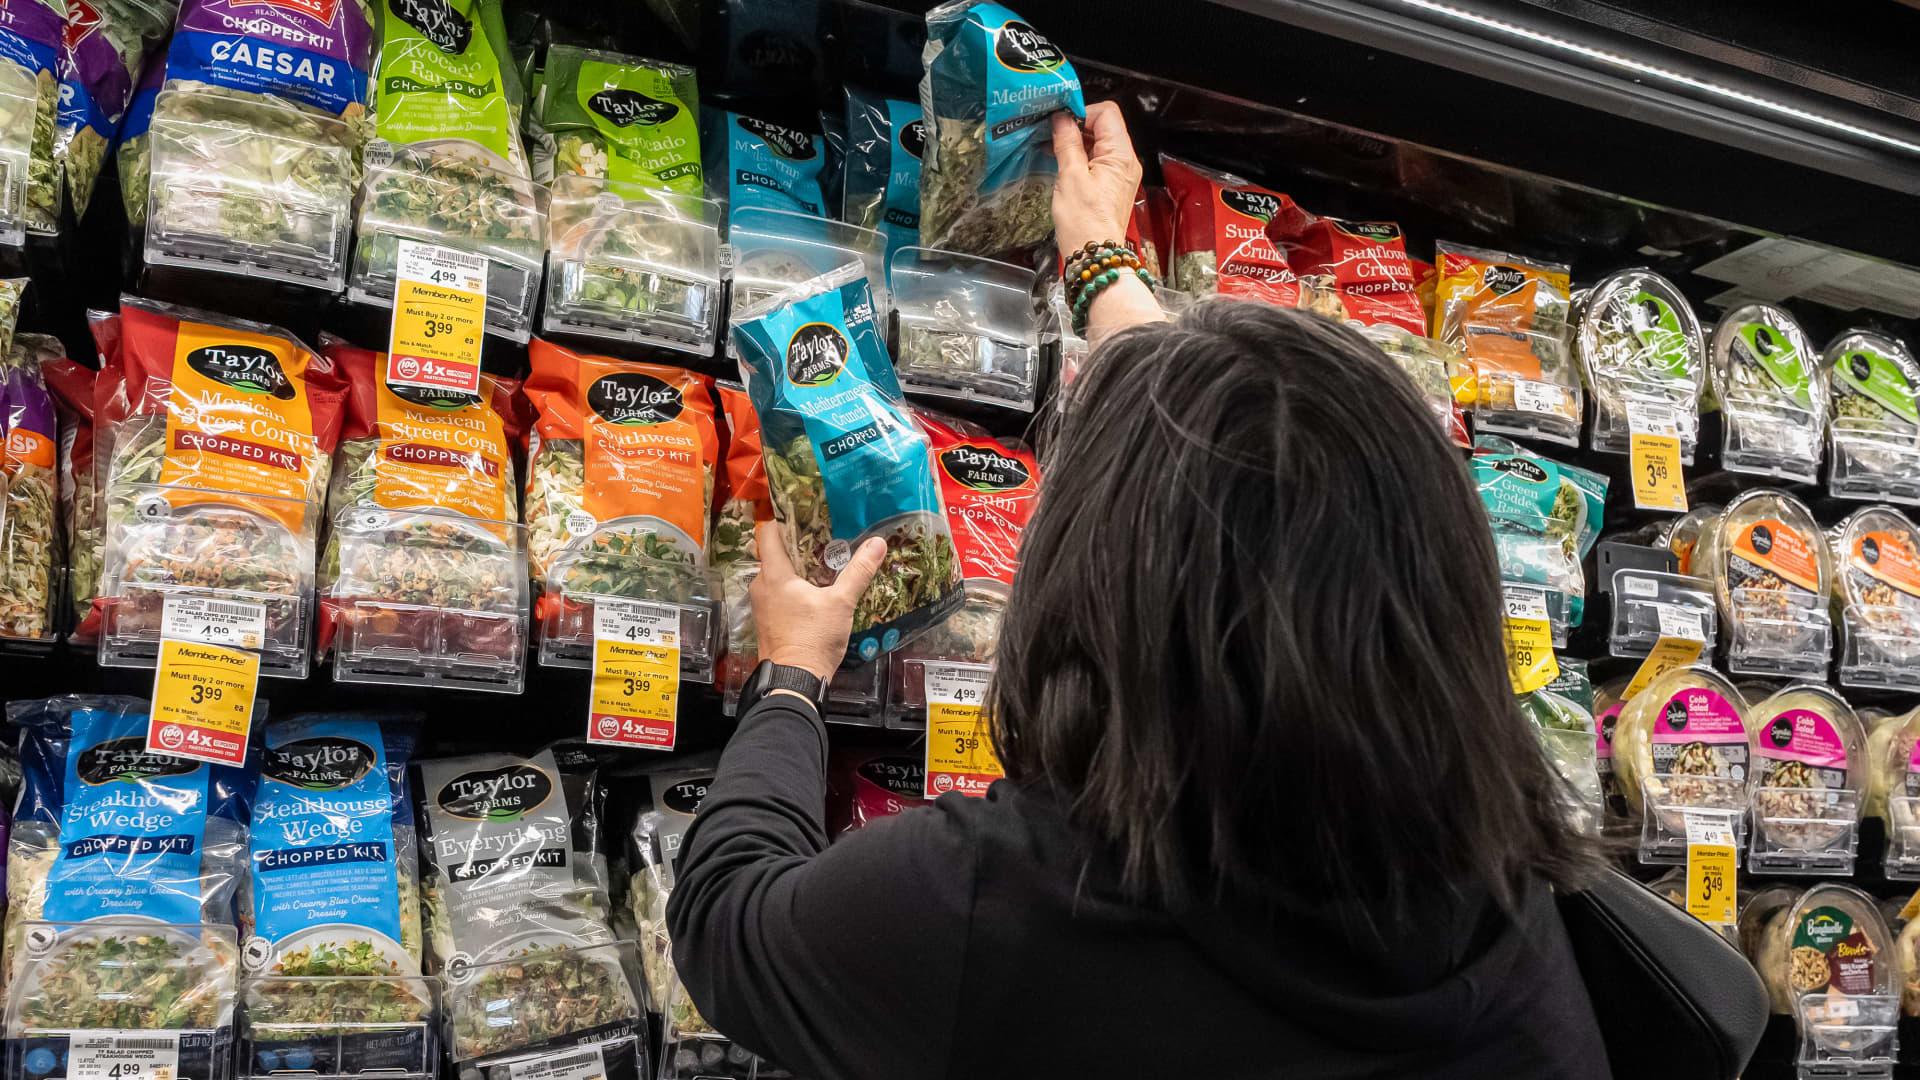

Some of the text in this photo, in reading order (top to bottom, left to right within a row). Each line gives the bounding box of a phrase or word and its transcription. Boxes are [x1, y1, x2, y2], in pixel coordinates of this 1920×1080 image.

[222, 16, 334, 50] CHOPPED KIT
[210, 40, 336, 87] CAESAR
[597, 95, 664, 116] Taylor
[748, 118, 809, 151] Taylor
[1228, 263, 1277, 279] CHOPPED
[1356, 262, 1412, 278] Crunch
[412, 287, 474, 305] Member Price!
[1346, 282, 1406, 294] CHOPPED
[406, 308, 424, 316] Must
[425, 311, 439, 319] Buy
[455, 317, 474, 325] more
[792, 335, 835, 364] Taylor
[204, 347, 285, 385] Taylor
[401, 361, 446, 376] 100 4x
[803, 360, 831, 378] FARMS
[222, 370, 271, 387] FARMS
[419, 389, 468, 399] FARMS
[601, 380, 673, 408] Taylor
[405, 409, 488, 432] Mexican
[613, 407, 656, 419] FARMS
[831, 402, 870, 426] Crunch
[250, 418, 303, 447] Corn
[391, 422, 499, 456] Street Corn
[593, 423, 695, 447] Southwest
[828, 427, 877, 455] CHOPPED
[181, 434, 297, 472] CHOPPED KIT
[392, 447, 469, 467] CHOPPED
[598, 440, 692, 462] CHOPPED KIT
[952, 449, 1018, 471] Taylor
[968, 470, 1005, 483] FARMS
[1502, 479, 1539, 499] Green
[147, 504, 158, 517] 6
[366, 516, 377, 524] 6
[178, 648, 246, 666] Member Price!
[610, 646, 668, 659] Member Price!
[171, 671, 190, 681] Must
[192, 674, 206, 684] Buy
[225, 681, 245, 689] more
[605, 667, 622, 675] Must
[623, 669, 637, 677] Buy
[234, 703, 244, 712] ea
[1689, 695, 1708, 704] Cobb
[1689, 704, 1709, 712] Salad
[941, 707, 970, 716] Member
[163, 727, 213, 747] 100 4x
[955, 730, 966, 738] Buy
[278, 745, 360, 773] Taylor
[109, 763, 161, 774] FARMS
[293, 769, 342, 781] FARMS
[451, 773, 536, 799] Taylor
[936, 775, 977, 790] 100 4x
[254, 797, 389, 824] Steakhouse
[473, 796, 522, 811] FARMS
[90, 810, 173, 832] Wedge
[280, 819, 364, 841] Wedge
[73, 837, 190, 857] CHOPPED KIT
[265, 846, 380, 867] CHOPPED KIT
[455, 852, 561, 878] CHOPPED KIT
[64, 884, 147, 899] with Creamy Blue
[100, 898, 144, 910] Dressing
[272, 894, 381, 912] with Creamy Blue Cheese
[307, 908, 348, 920] Dressing
